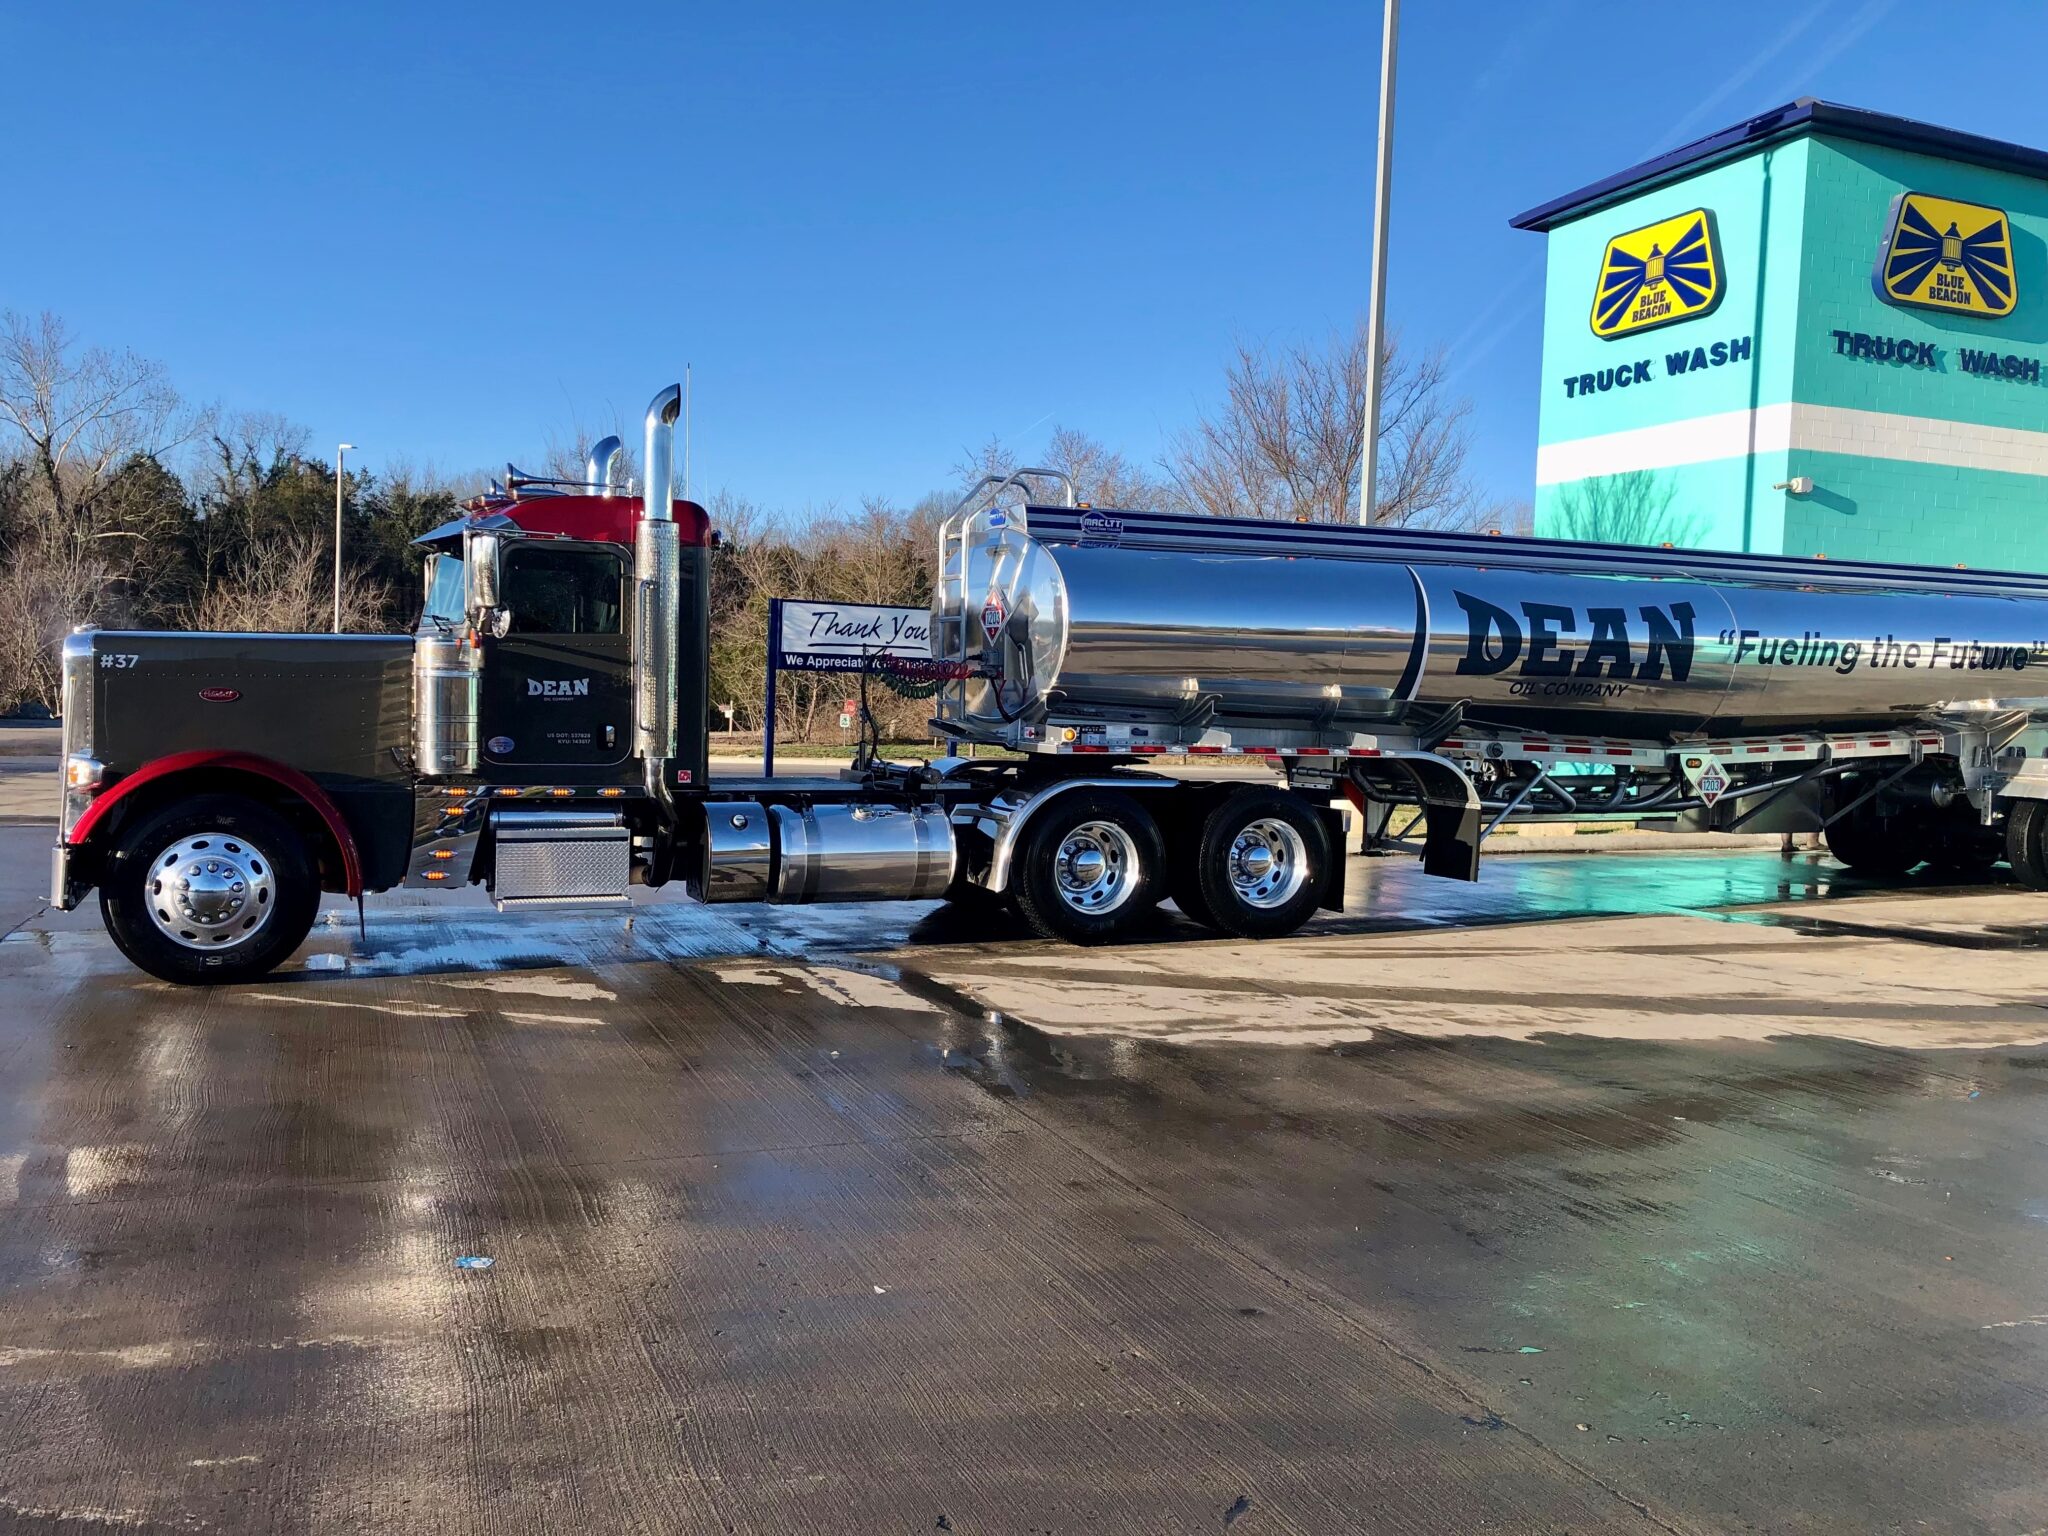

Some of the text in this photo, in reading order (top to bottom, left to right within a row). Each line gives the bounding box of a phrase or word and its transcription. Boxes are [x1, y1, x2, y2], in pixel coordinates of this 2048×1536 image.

[1936, 273, 1965, 290] BLUE
[1640, 290, 1667, 308] BLUE
[1929, 286, 1971, 305] BEACON
[1632, 301, 1672, 323] BEACON
[1832, 330, 2040, 382] TRUCK WASH
[1563, 336, 1751, 398] TRUCK WASH
[809, 611, 929, 644] Thank You
[1452, 589, 1696, 682] DEAN
[785, 654, 804, 666] We
[1870, 634, 1921, 668] the
[100, 654, 139, 668] #37
[527, 678, 590, 696] DEAN
[1509, 681, 1629, 697] OIL COMPANY
[1703, 780, 1720, 791] 1203
